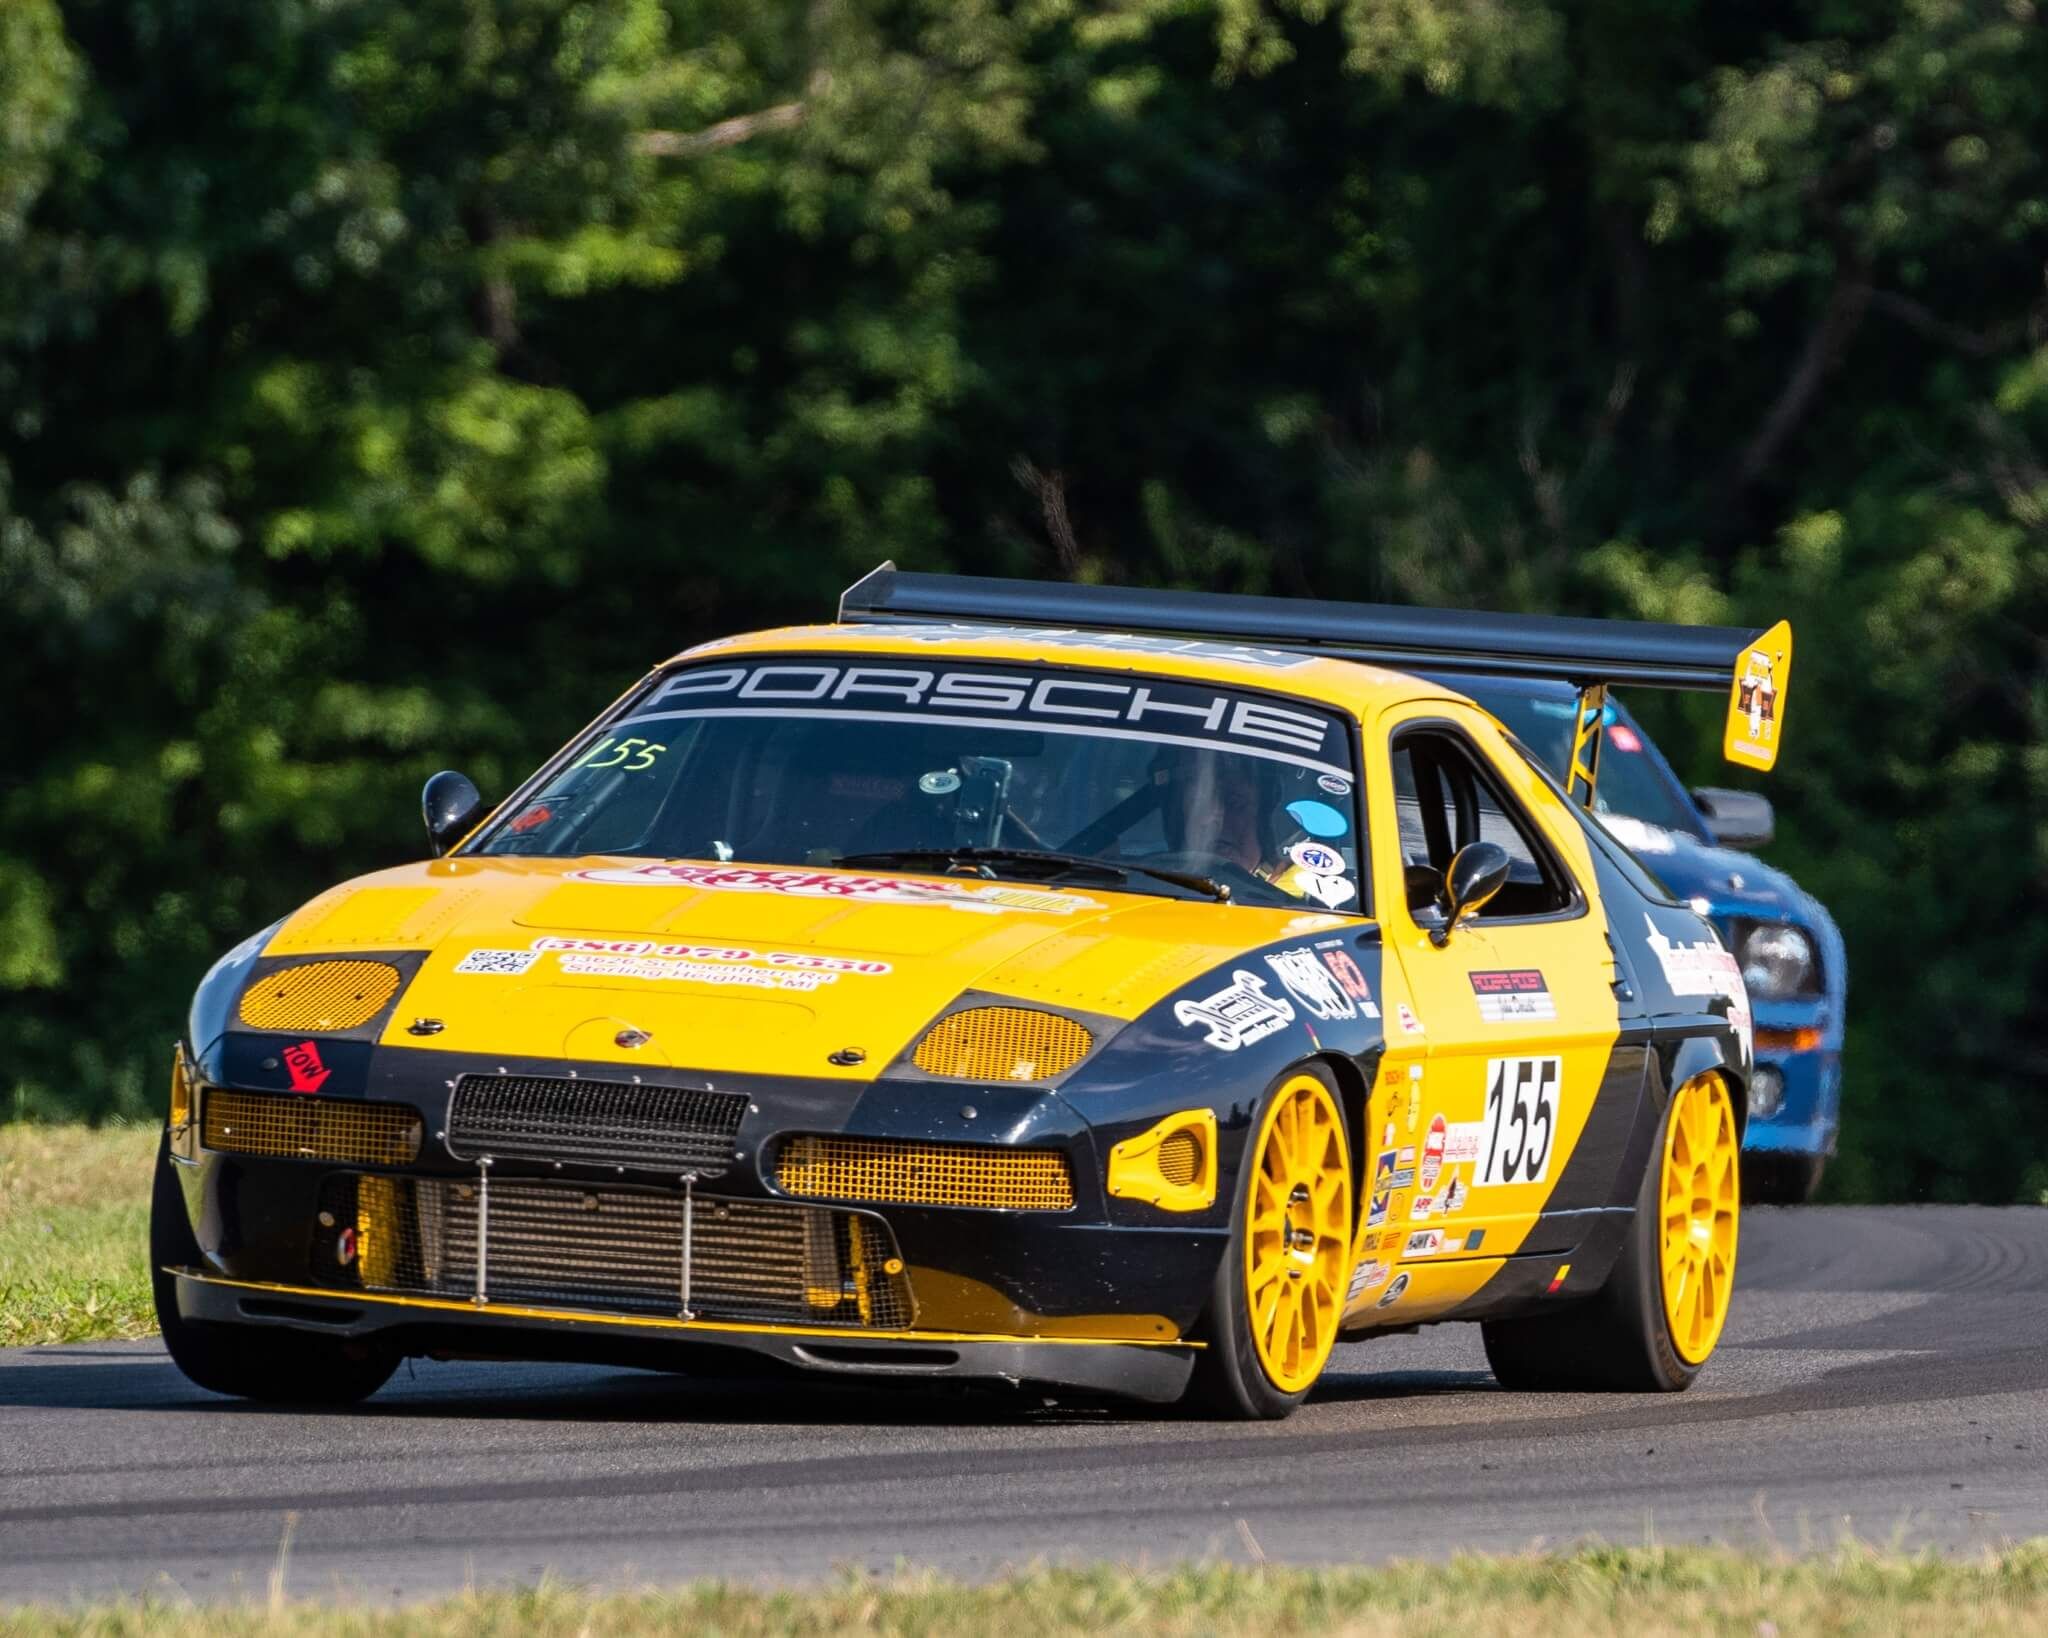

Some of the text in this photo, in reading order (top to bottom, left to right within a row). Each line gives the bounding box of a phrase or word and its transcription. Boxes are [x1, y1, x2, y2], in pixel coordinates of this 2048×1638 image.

[646, 666, 1328, 752] PORSCHE
[572, 738, 667, 770] 155
[536, 939, 886, 973] (586) 979-7550
[567, 964, 663, 979] Sterling
[784, 979, 814, 989] MI
[284, 1046, 322, 1079] TOW
[1484, 1060, 1556, 1183] 155
